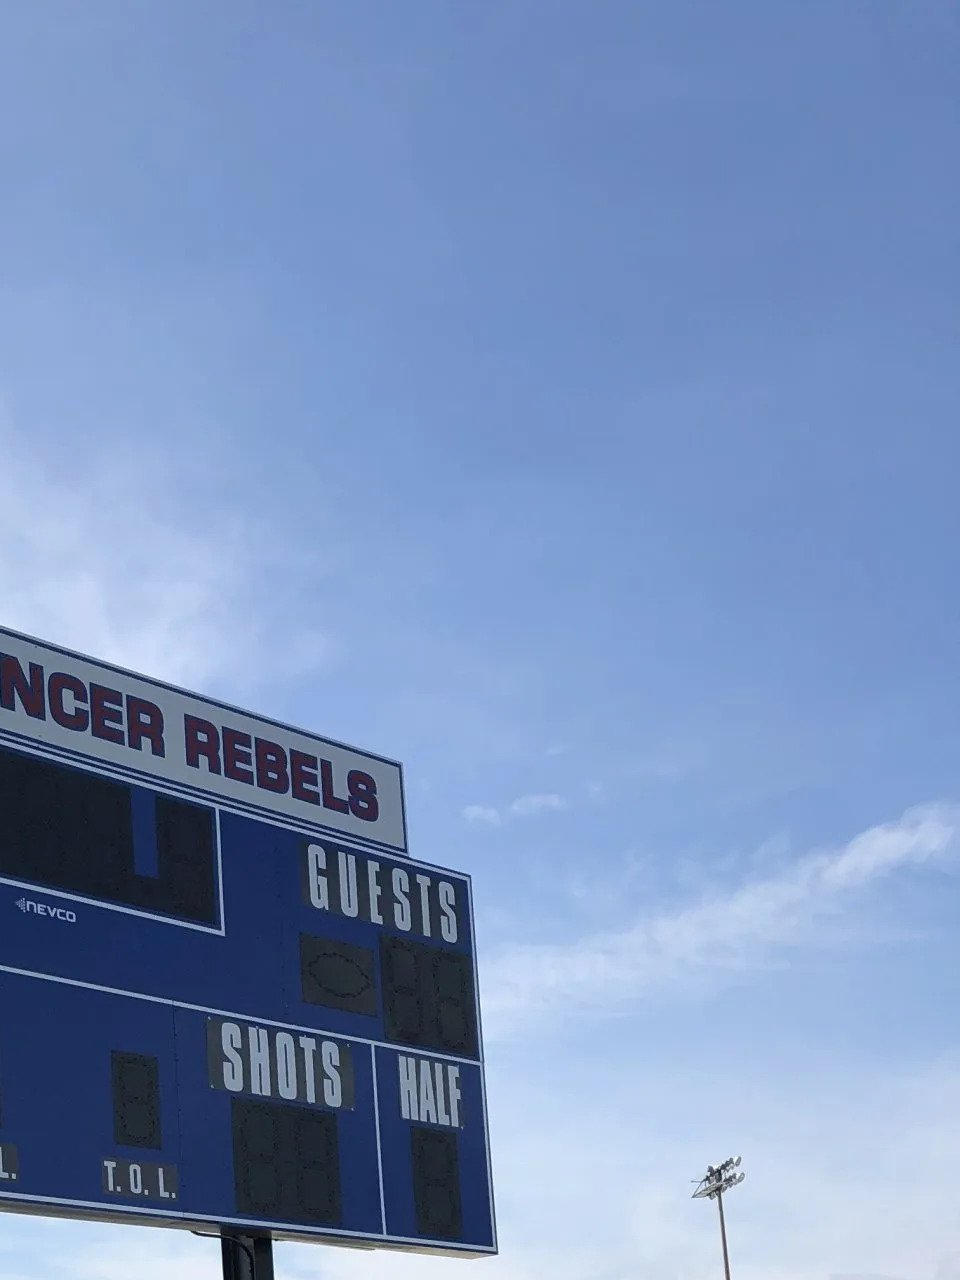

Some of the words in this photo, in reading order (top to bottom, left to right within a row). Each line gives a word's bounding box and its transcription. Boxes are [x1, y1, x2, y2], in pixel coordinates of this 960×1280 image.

[183, 713, 380, 822] REBELS
[306, 844, 459, 945] GUESTS
[221, 1022, 342, 1108] SHOTS
[398, 1054, 462, 1129] HALF
